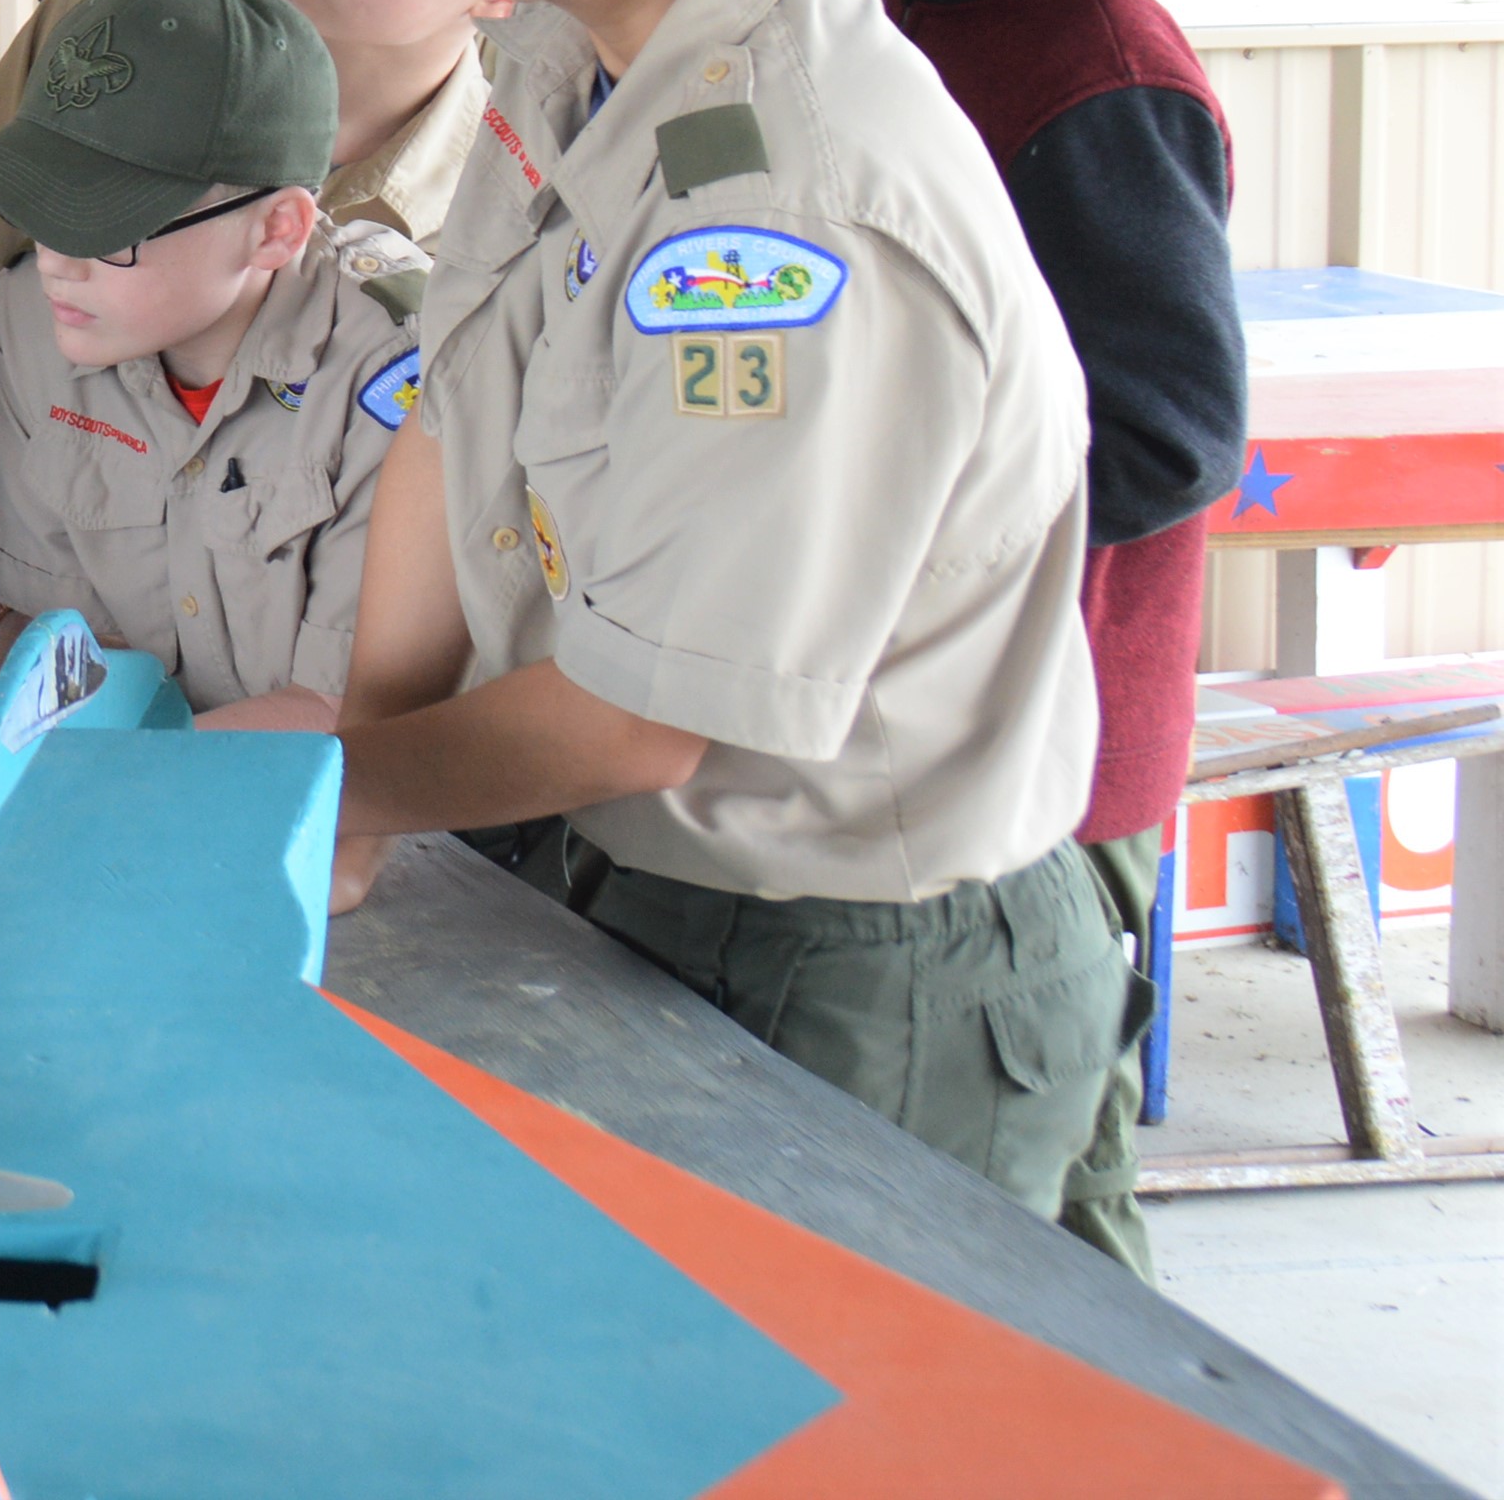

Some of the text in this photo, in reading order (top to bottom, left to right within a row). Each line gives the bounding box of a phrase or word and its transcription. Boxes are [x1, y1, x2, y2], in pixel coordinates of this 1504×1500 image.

[677, 236, 742, 255] RIVERS
[370, 362, 410, 400] THREE
[683, 345, 771, 407] 23
[67, 411, 112, 437] SCOUTS
